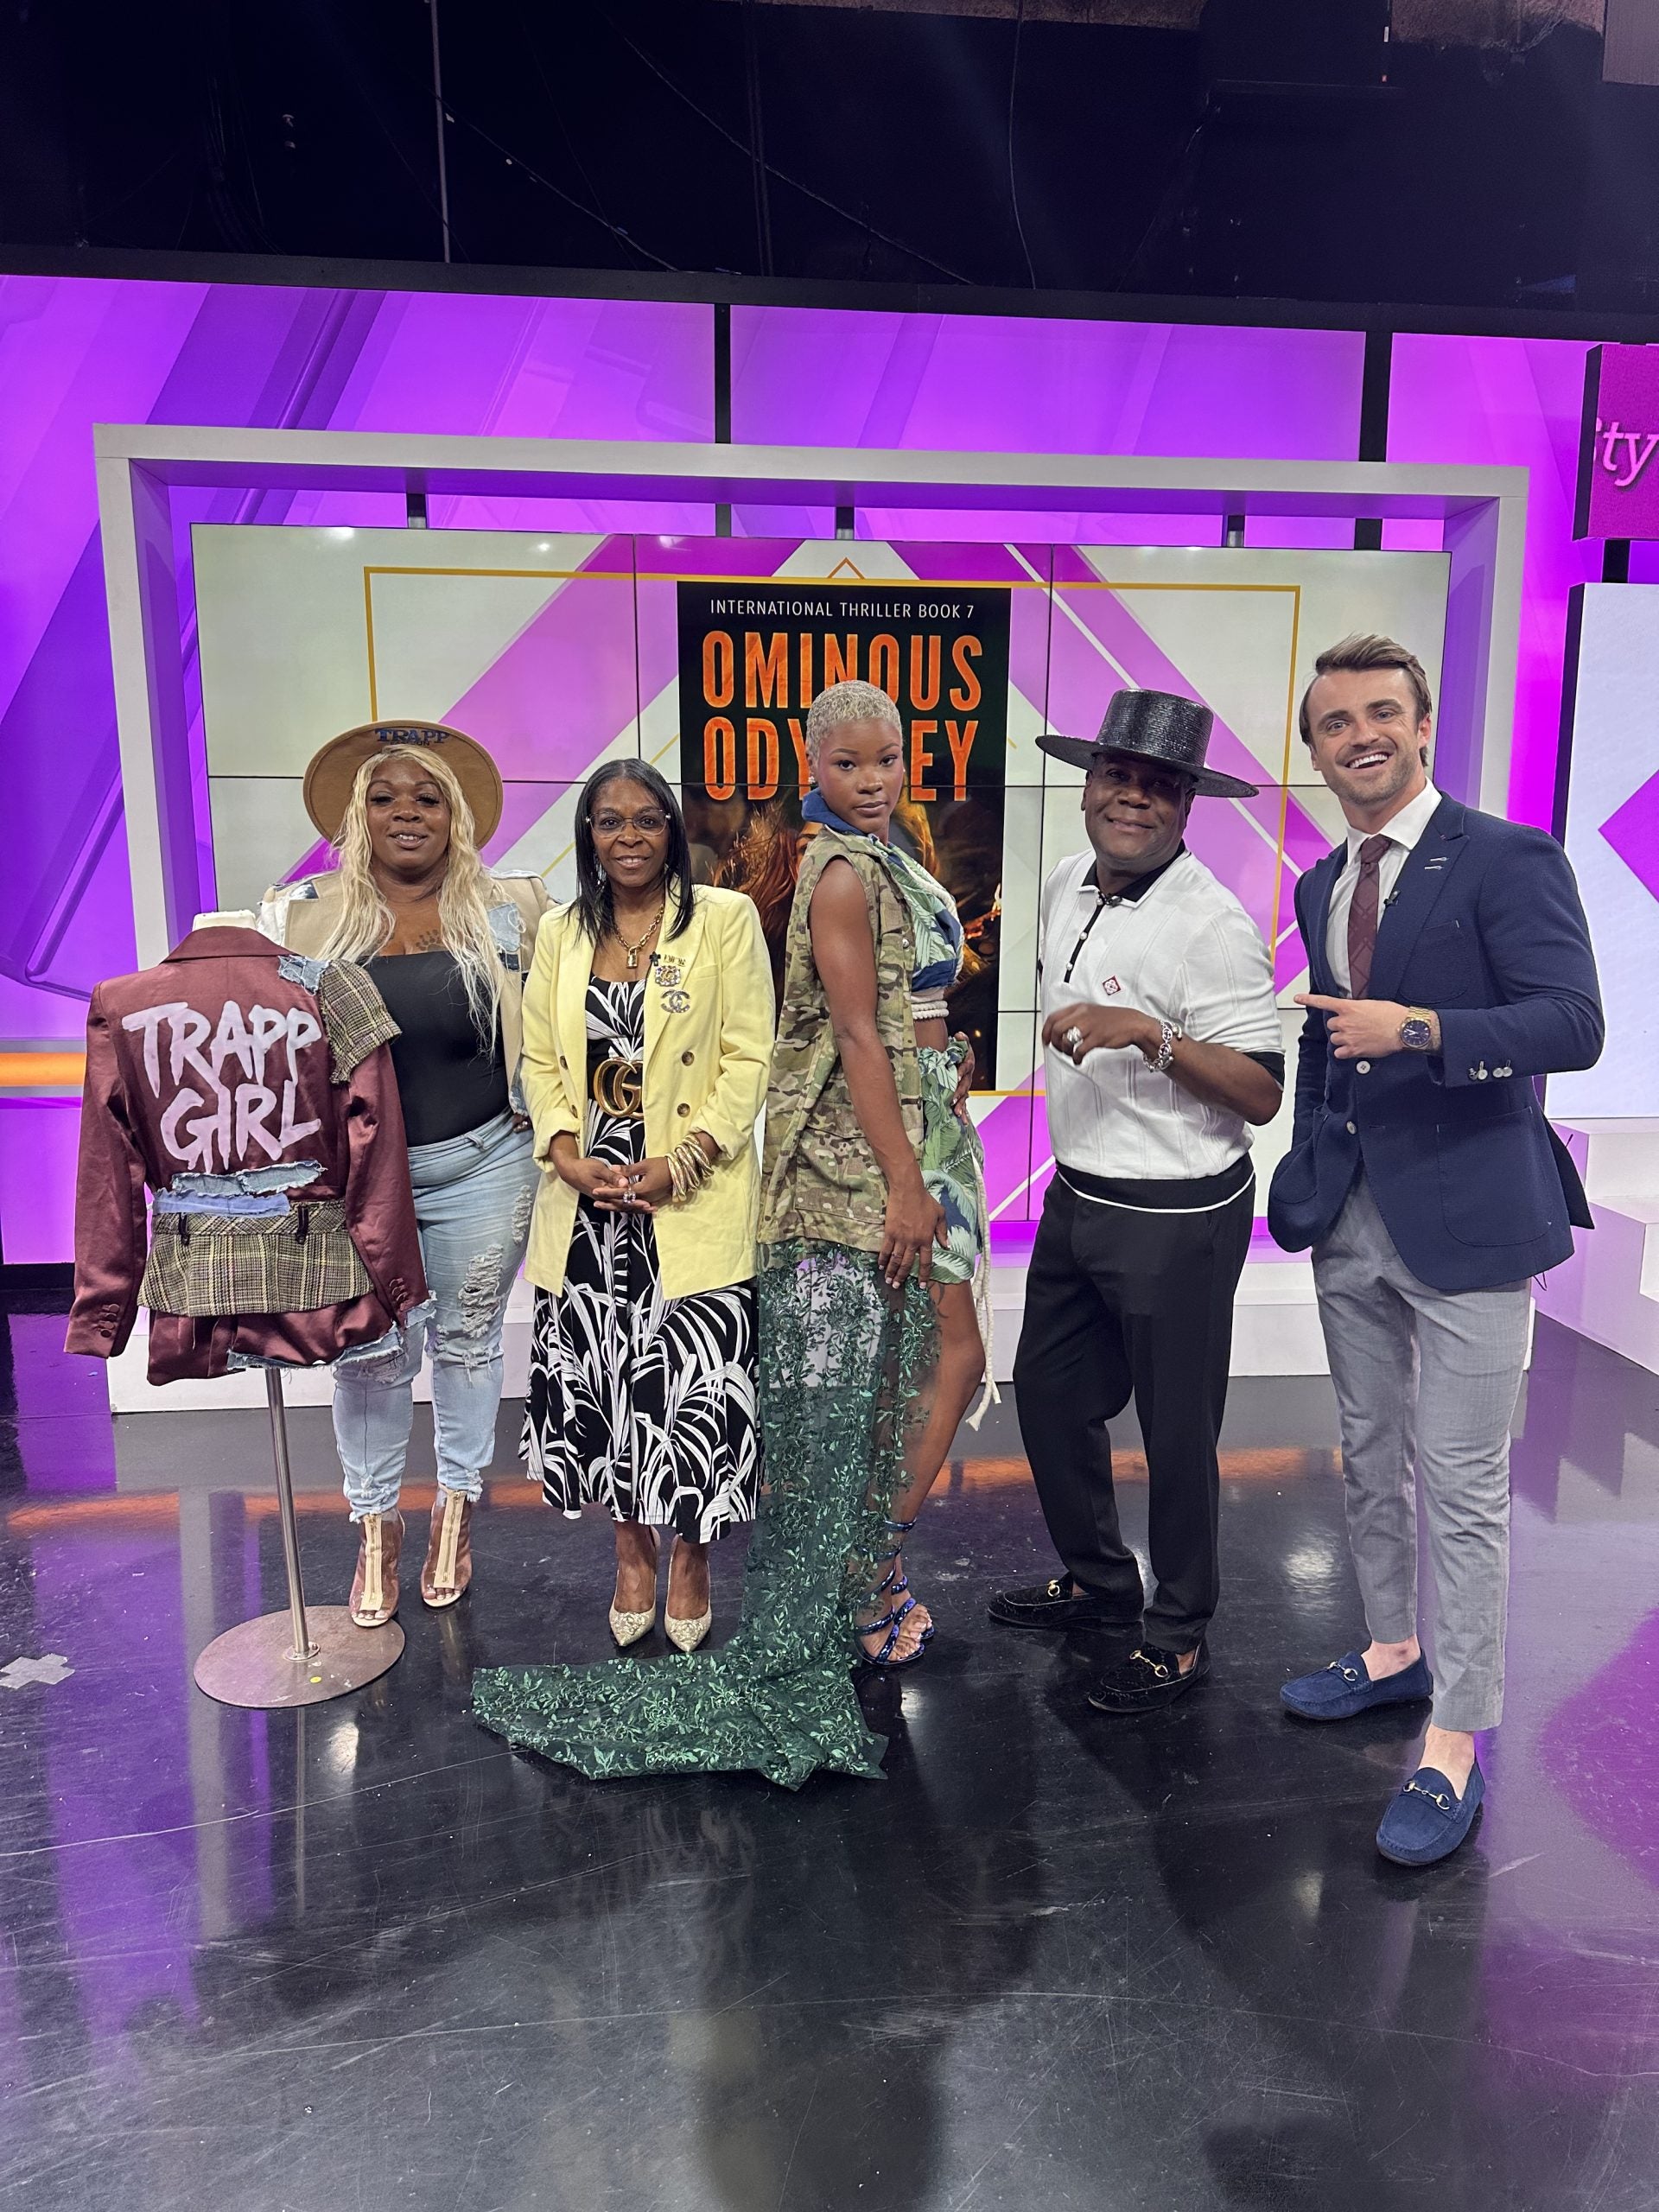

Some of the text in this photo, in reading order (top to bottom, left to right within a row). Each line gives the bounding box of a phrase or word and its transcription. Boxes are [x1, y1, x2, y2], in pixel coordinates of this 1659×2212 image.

[1594, 417, 1659, 486] ty
[710, 600, 975, 619] INTERNATIONAL THRILLER BOOK 7
[702, 631, 983, 711] OMINOUS
[375, 728, 450, 743] TRAPP
[703, 716, 979, 801] ODYEY
[122, 1001, 322, 1098] TRAPP
[161, 1080, 321, 1173] GIRL
